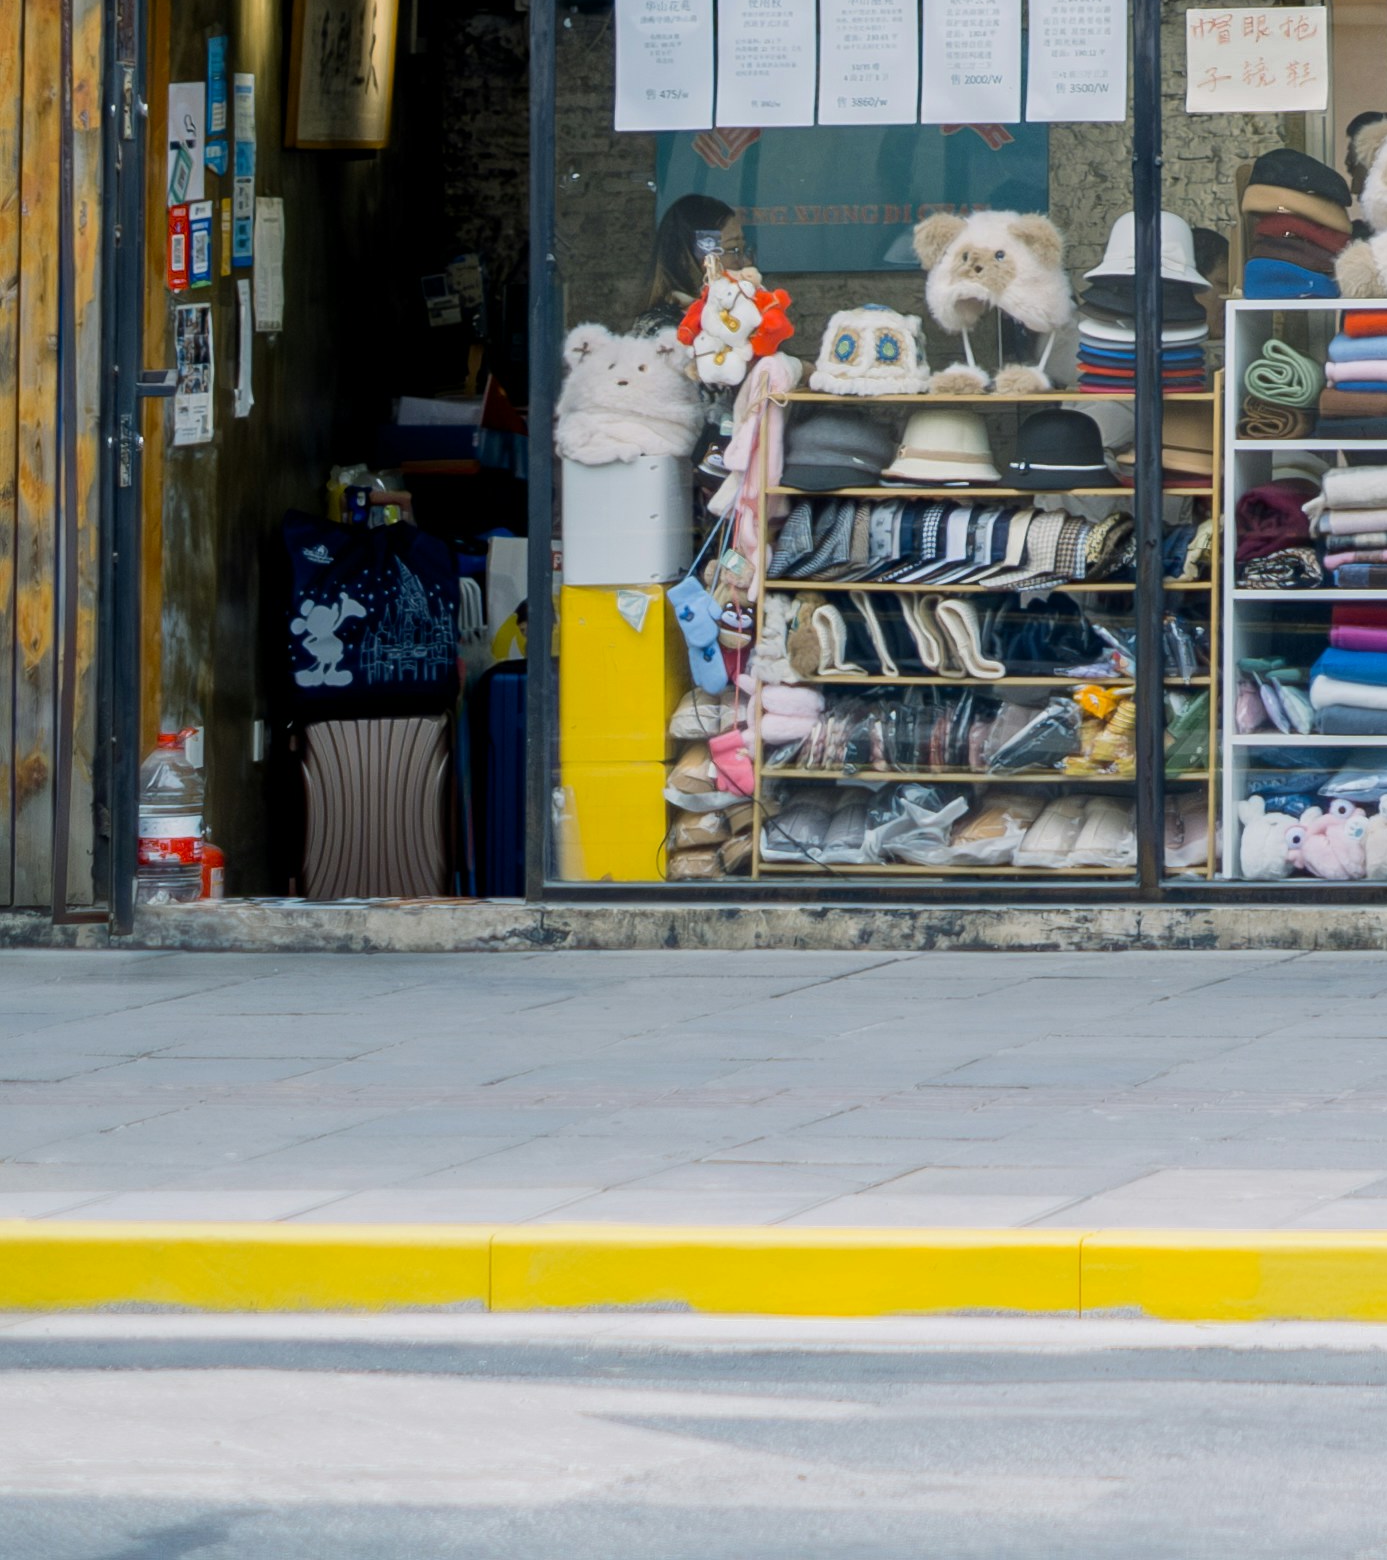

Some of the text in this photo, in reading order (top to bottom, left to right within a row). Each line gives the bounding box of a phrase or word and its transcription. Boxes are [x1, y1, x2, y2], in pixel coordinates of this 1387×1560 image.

[951, 74, 1003, 85] 售 2000/W
[1069, 83, 1109, 94] 3500/W
